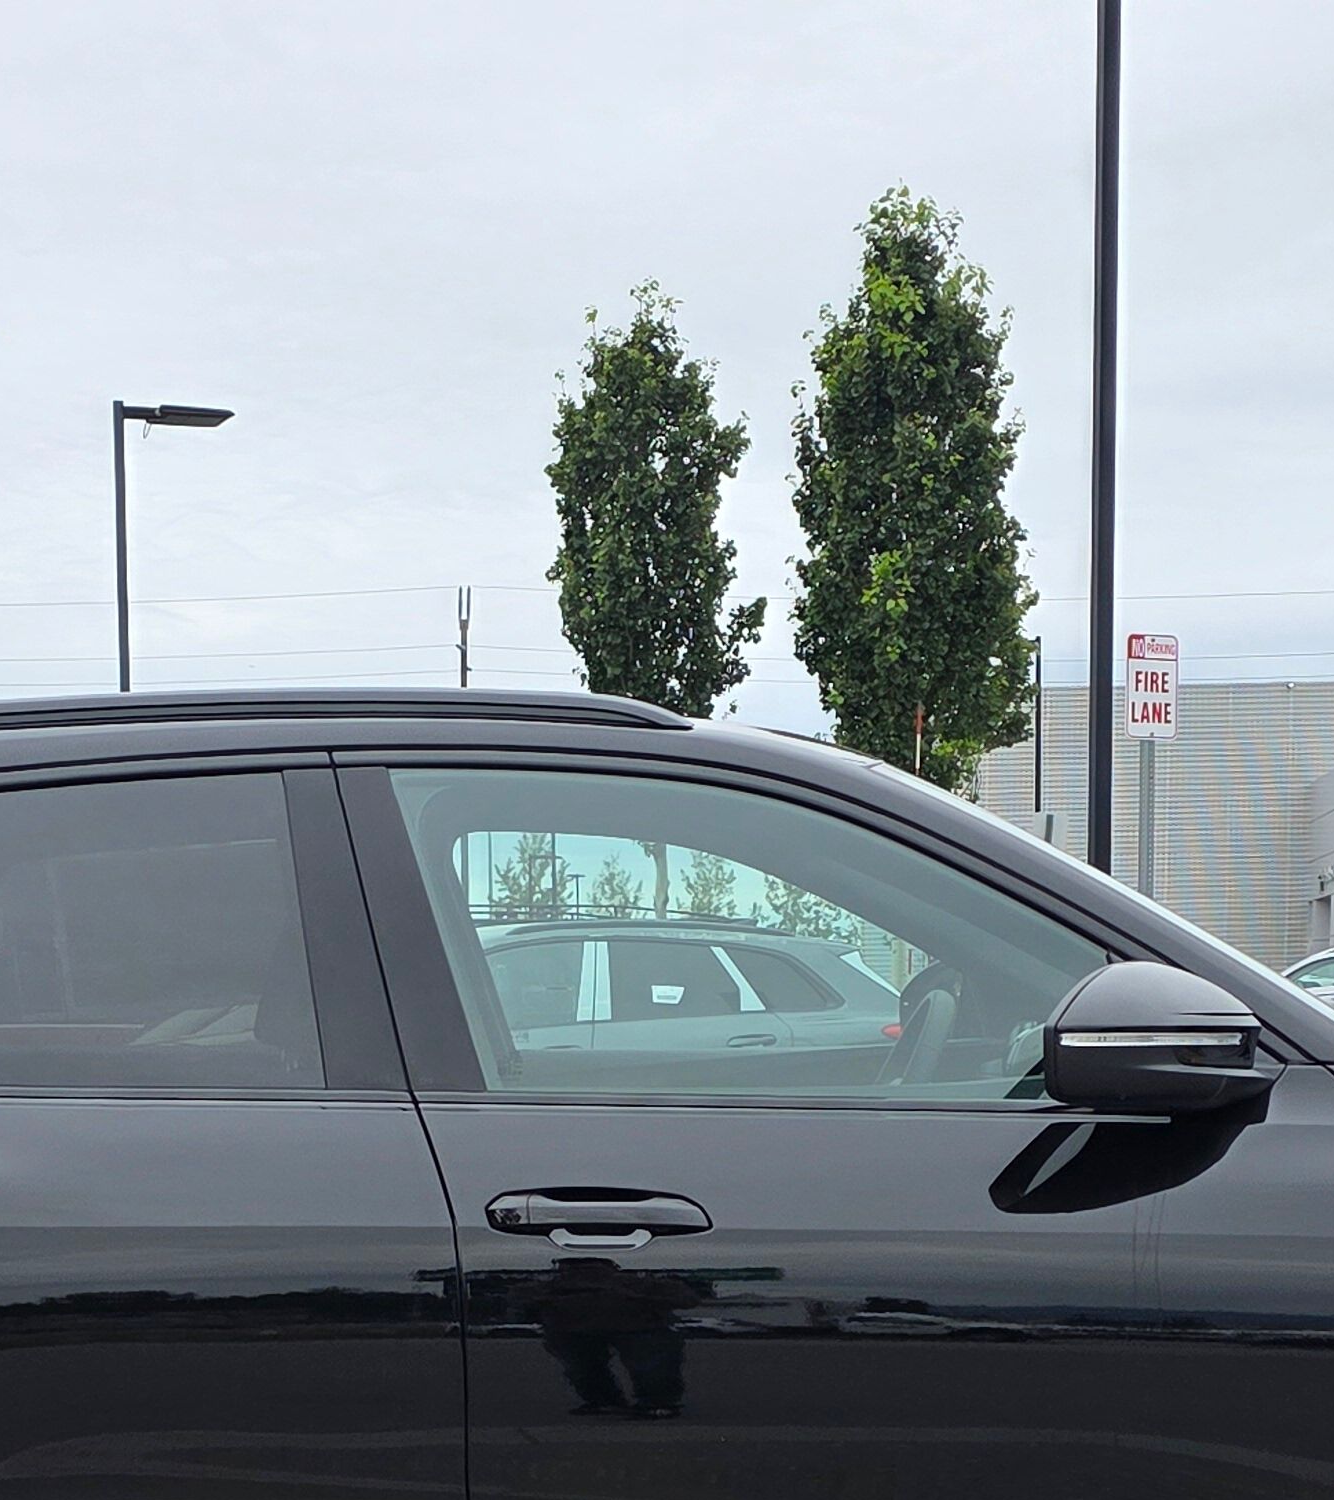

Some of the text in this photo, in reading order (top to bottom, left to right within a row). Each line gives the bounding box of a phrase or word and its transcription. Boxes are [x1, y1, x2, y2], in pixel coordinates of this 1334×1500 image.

[1147, 642, 1176, 656] PARKING
[1135, 670, 1169, 693] FIRE
[1131, 701, 1172, 724] LANE
